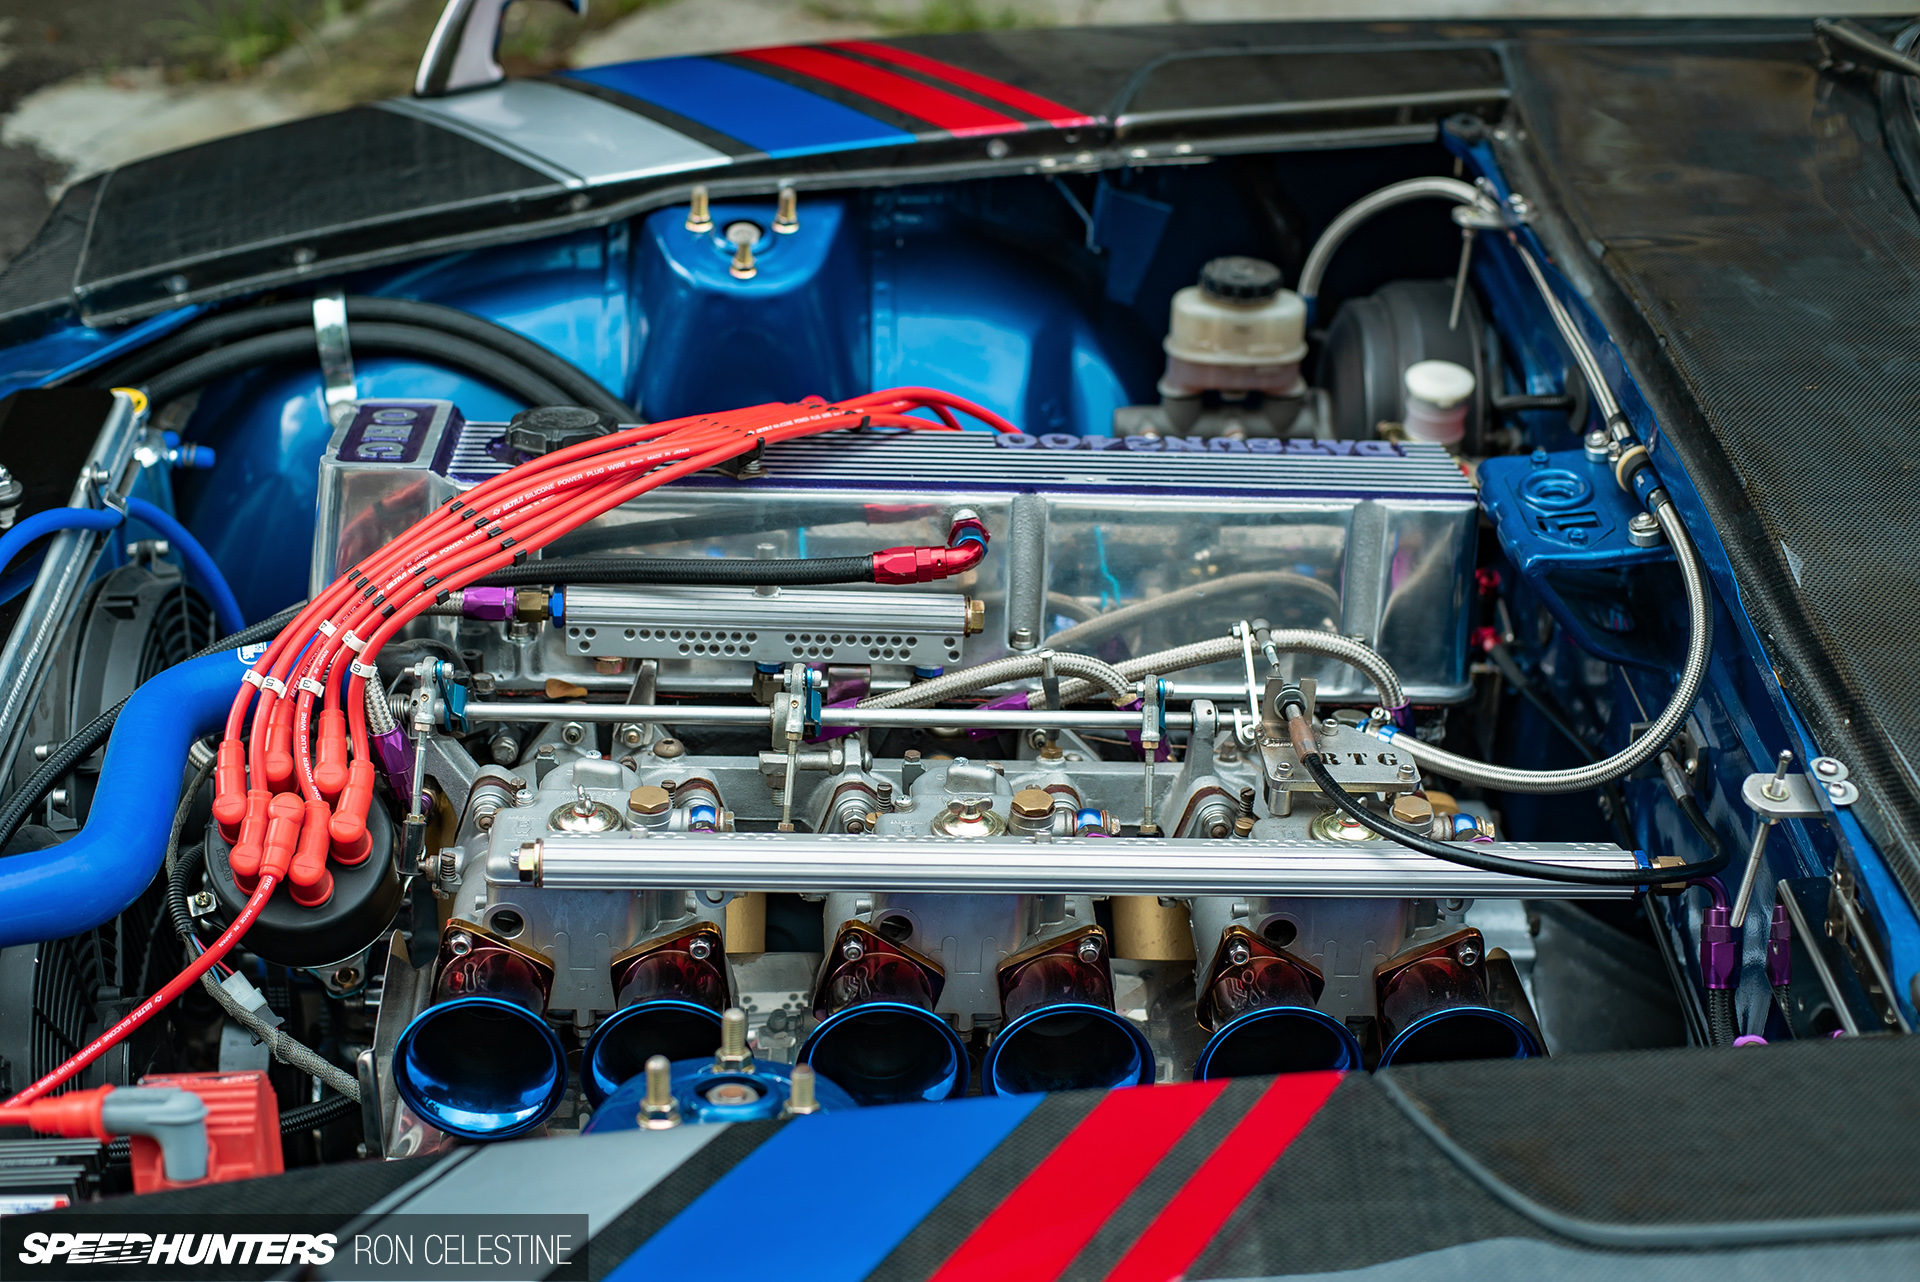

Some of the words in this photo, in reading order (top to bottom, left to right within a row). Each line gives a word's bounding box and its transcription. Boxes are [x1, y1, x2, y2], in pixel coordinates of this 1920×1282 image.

[356, 407, 418, 460] OHC
[525, 483, 555, 499] SILICONE
[557, 473, 583, 486] POWER
[586, 467, 605, 477] PLUG
[607, 461, 627, 471] WIRE
[647, 452, 662, 460] MADE
[407, 553, 438, 573] SILICONE
[439, 539, 464, 555] POWER
[465, 529, 482, 540] PLUG
[484, 519, 502, 530] WIRE
[344, 632, 353, 643] 2
[318, 649, 330, 666] JAPAN
[352, 663, 362, 673] 6
[265, 678, 275, 687] 5
[302, 679, 312, 688] 3
[300, 711, 308, 730] WIRE
[300, 735, 308, 753] PLUG
[303, 756, 314, 782] POWER
[262, 875, 273, 890] IRE
[240, 909, 253, 924] MADE
[218, 931, 233, 947] JAPAN
[102, 1018, 132, 1042] SILICONE
[76, 1041, 101, 1061] POWER
[57, 1060, 75, 1074] PLUG
[36, 1074, 56, 1088] WIRE
